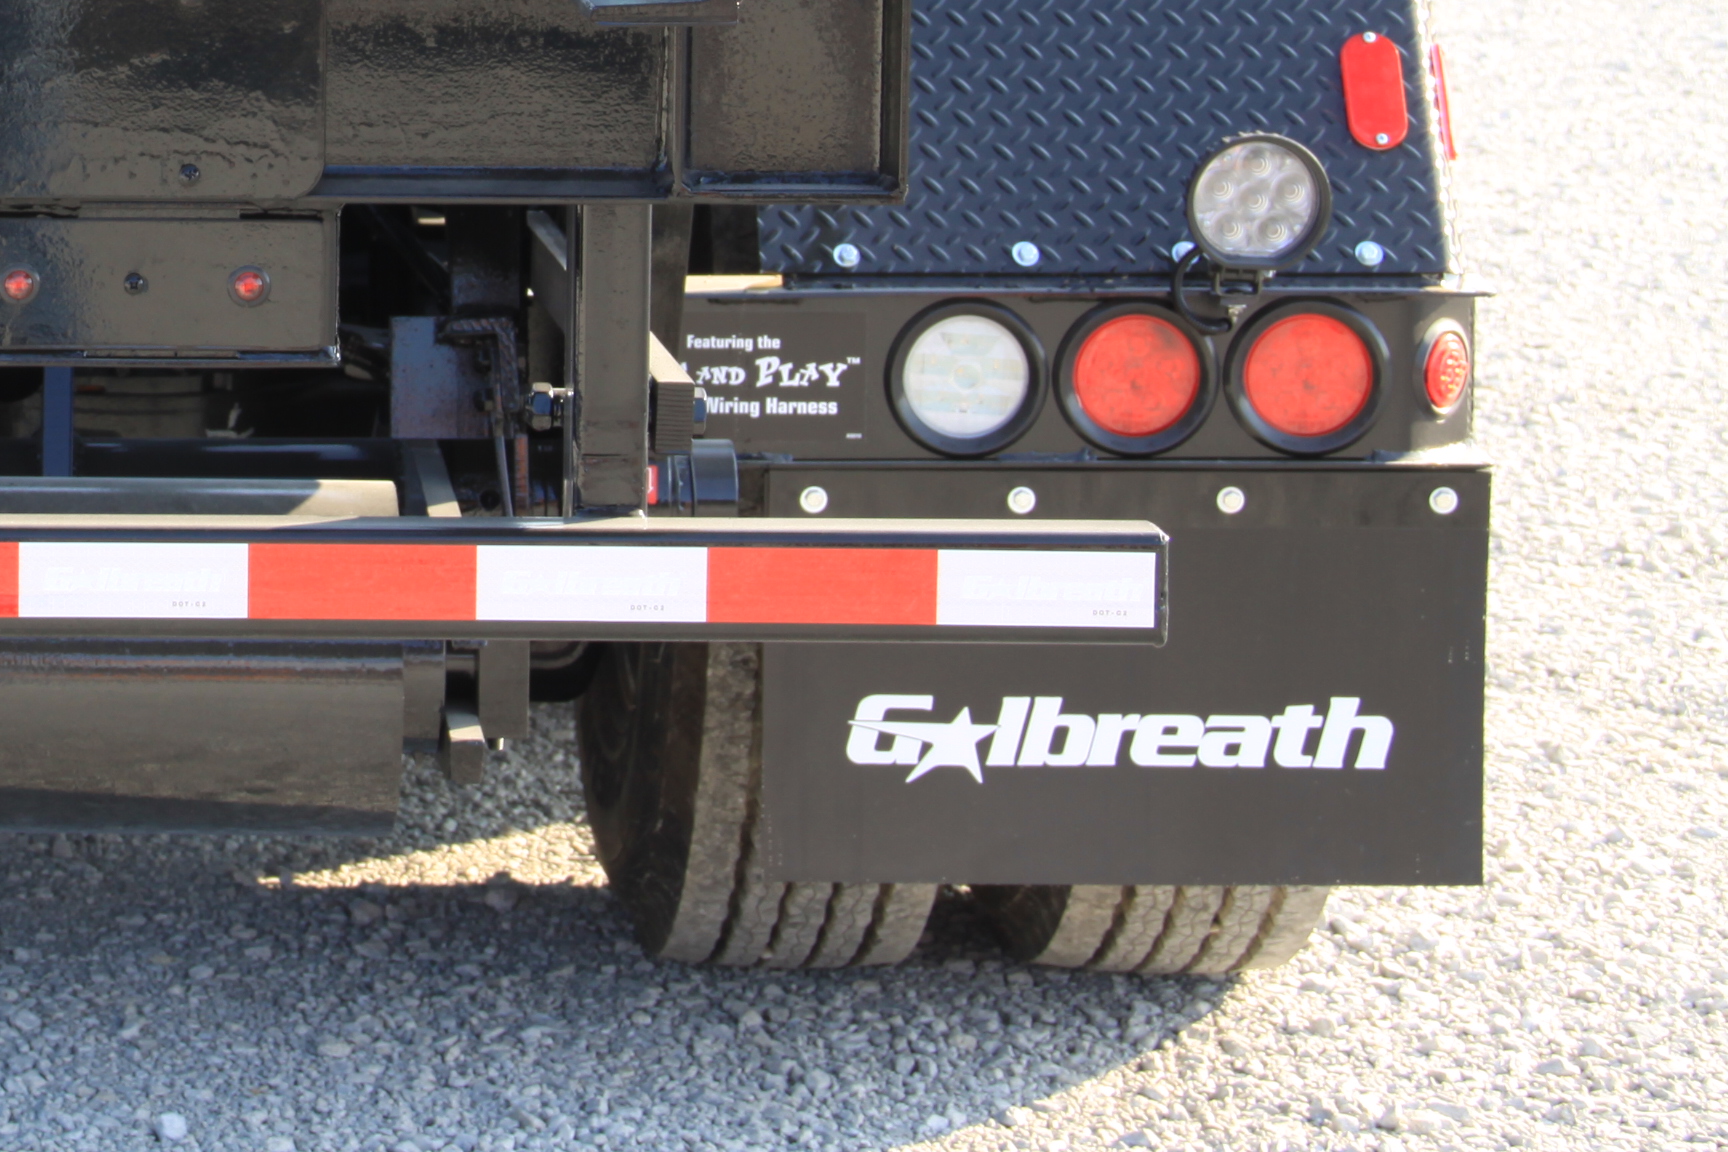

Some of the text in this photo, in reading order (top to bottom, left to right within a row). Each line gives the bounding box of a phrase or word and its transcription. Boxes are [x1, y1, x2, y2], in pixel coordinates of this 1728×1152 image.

[686, 334, 781, 352] Featuring the
[696, 366, 746, 385] AND
[705, 396, 839, 418] Wiring Harness
